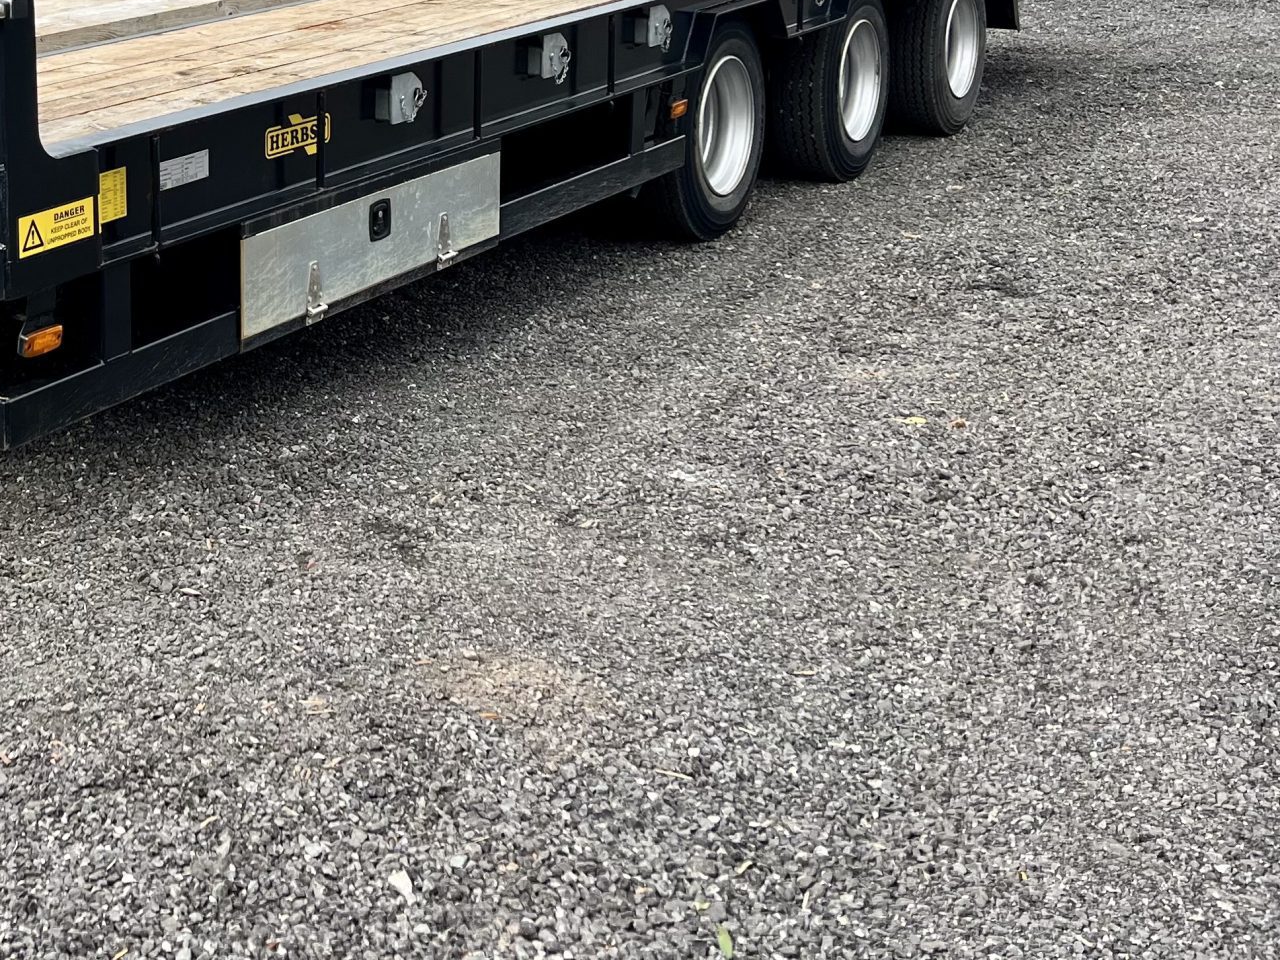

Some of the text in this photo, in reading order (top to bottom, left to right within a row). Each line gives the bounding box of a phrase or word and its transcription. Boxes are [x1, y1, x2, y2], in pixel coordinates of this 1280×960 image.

[269, 124, 318, 152] HERBS
[54, 205, 85, 221] DANGER
[64, 220, 80, 230] CLEAR
[47, 231, 77, 244] UNPROPPED
